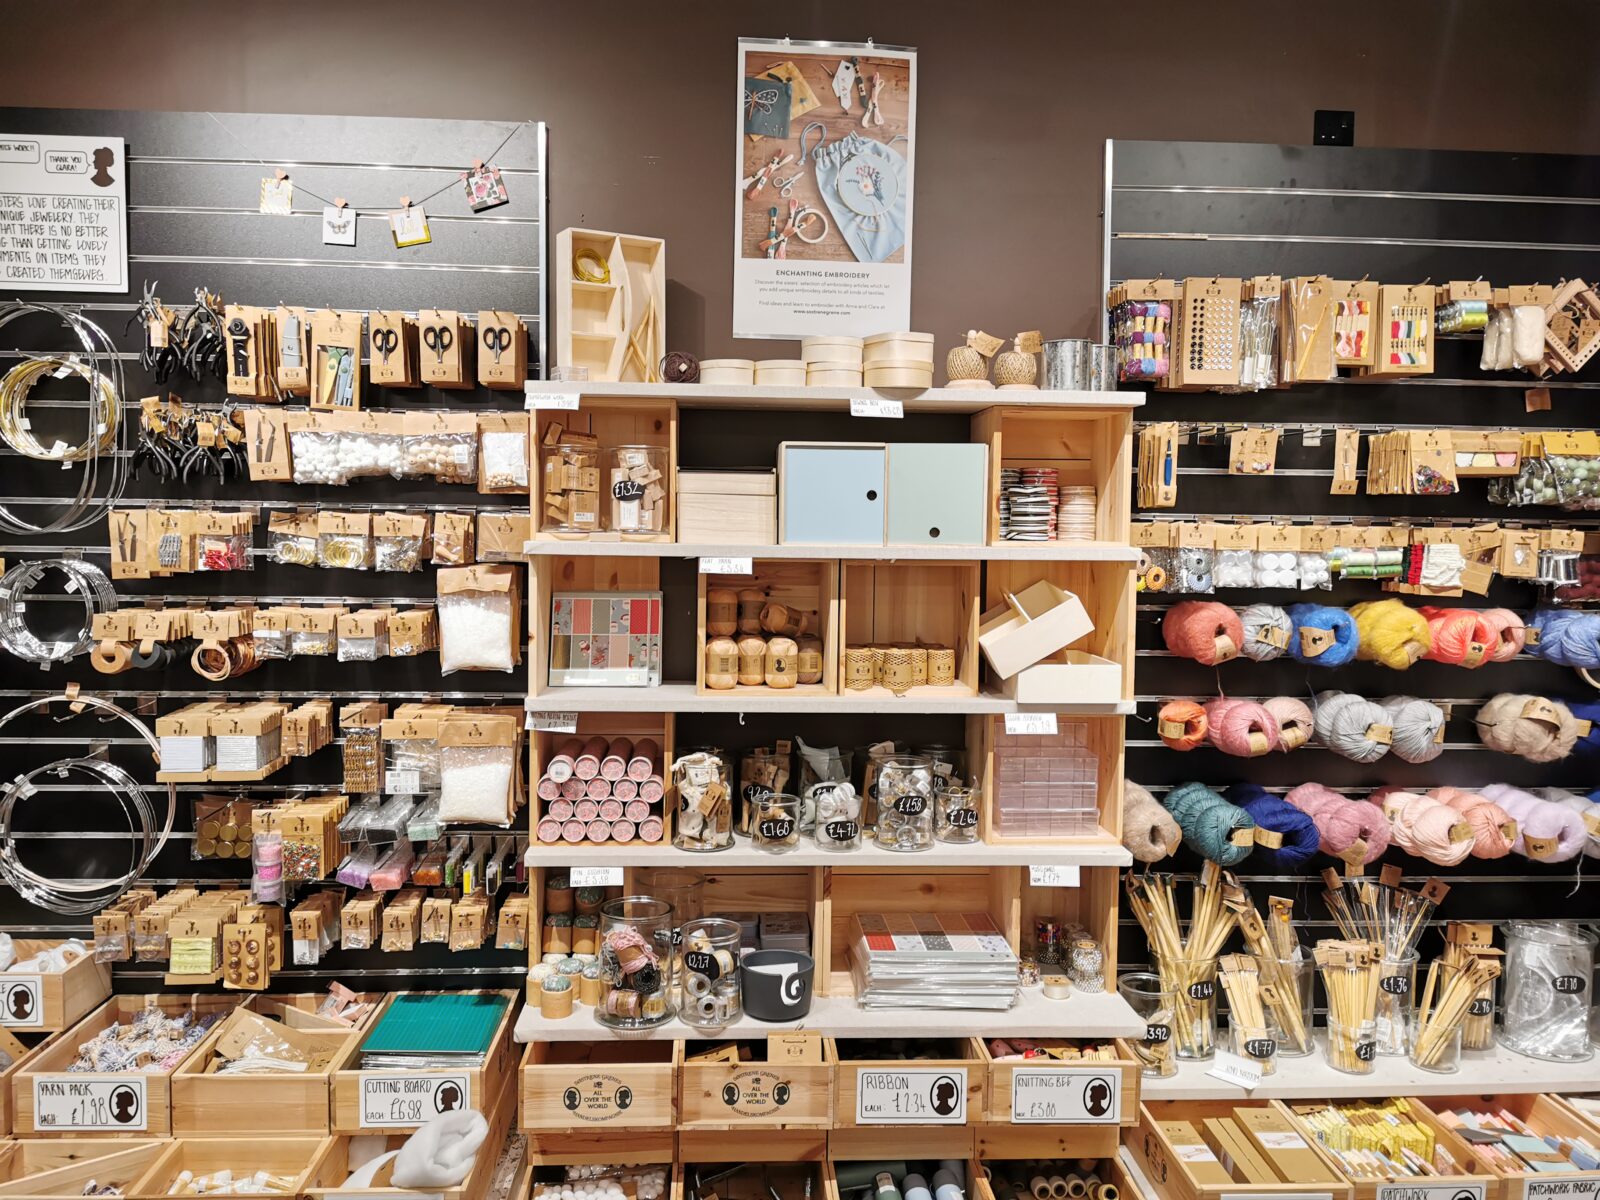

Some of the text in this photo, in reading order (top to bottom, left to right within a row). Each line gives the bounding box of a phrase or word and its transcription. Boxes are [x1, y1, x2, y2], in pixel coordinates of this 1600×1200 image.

[49, 155, 69, 163] THANK
[28, 197, 47, 208] LOVE
[52, 197, 92, 210] CREATING
[93, 198, 115, 210] THEIR
[80, 212, 100, 223] THEY
[18, 224, 44, 235] THERE
[49, 225, 57, 236] IS
[60, 226, 72, 236] NO
[75, 226, 109, 237] BETTER
[11, 237, 33, 248] THAN
[37, 238, 72, 250] GETTING
[77, 240, 107, 251] LOVELY
[36, 252, 47, 264] ON
[52, 253, 78, 265] ITEMS
[83, 254, 106, 265] THEY
[7, 266, 46, 279] CREATED
[776, 270, 870, 279] ENCHANTING EMBROIDERY
[1467, 1001, 1490, 1014] 2.96
[1144, 1026, 1168, 1041] 3.92
[366, 1079, 432, 1094] CUTTING BOARD
[866, 1074, 909, 1090] RIBBON
[1017, 1076, 1054, 1088] KNITTING
[40, 1083, 93, 1096] YARN PACK
